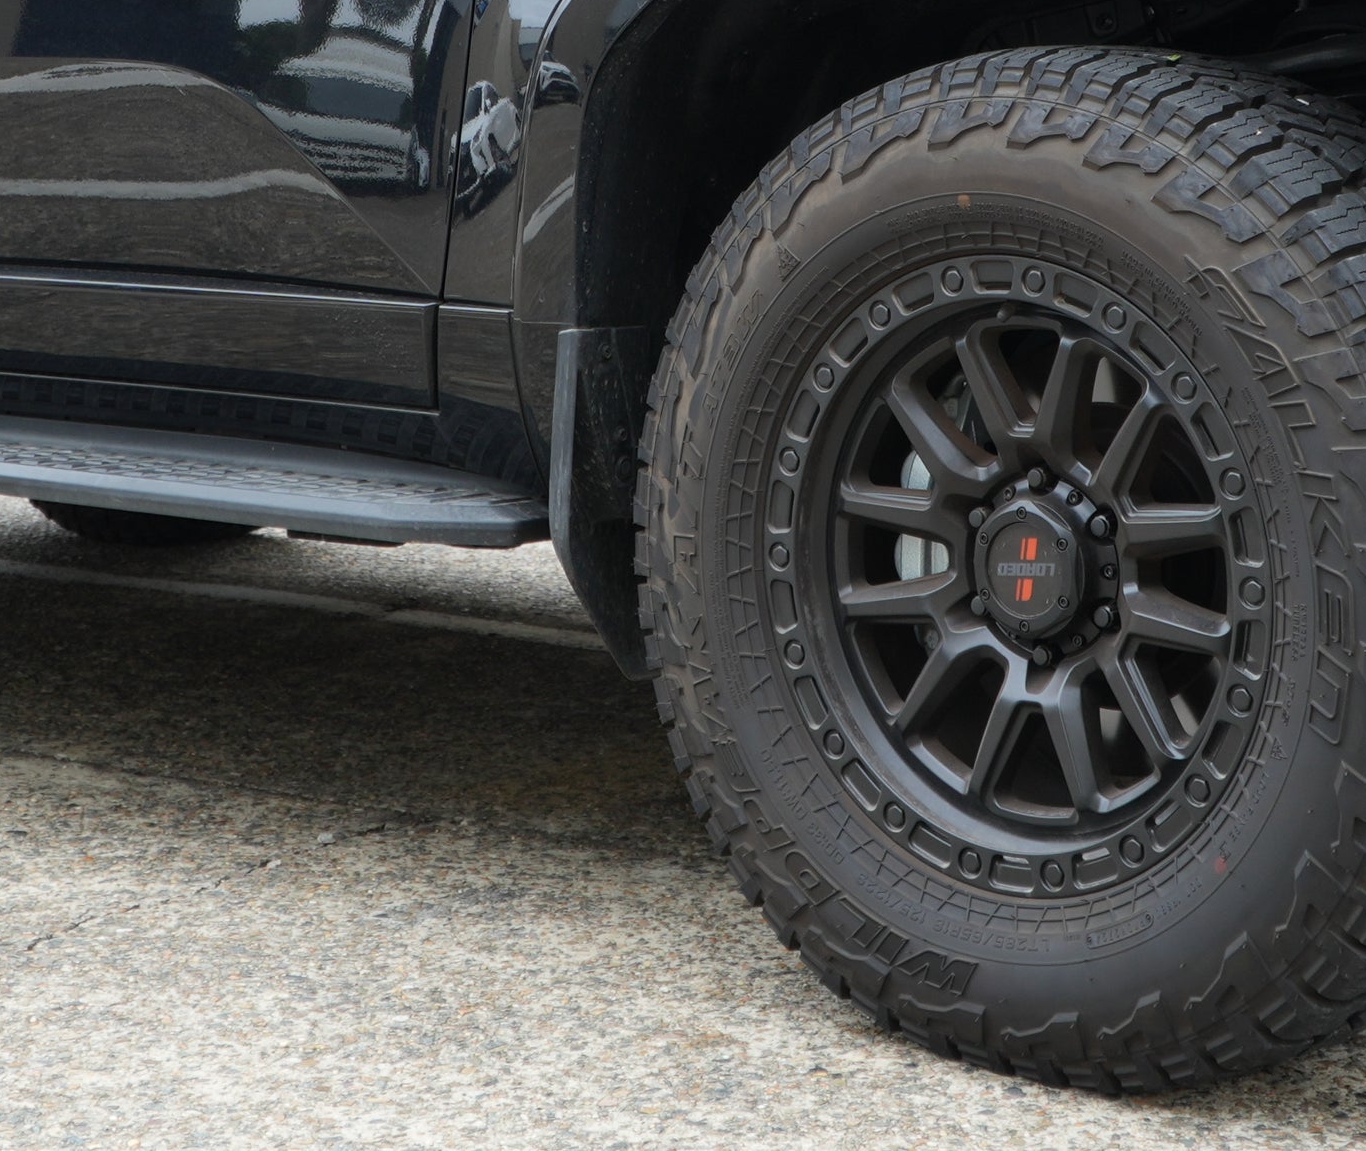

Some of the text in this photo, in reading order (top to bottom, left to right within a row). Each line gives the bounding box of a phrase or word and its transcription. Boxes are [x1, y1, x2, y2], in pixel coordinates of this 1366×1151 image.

[997, 563, 1056, 577] LOADED
[1185, 263, 1351, 746] FALKEN
[687, 615, 979, 996] WILDPEAK
